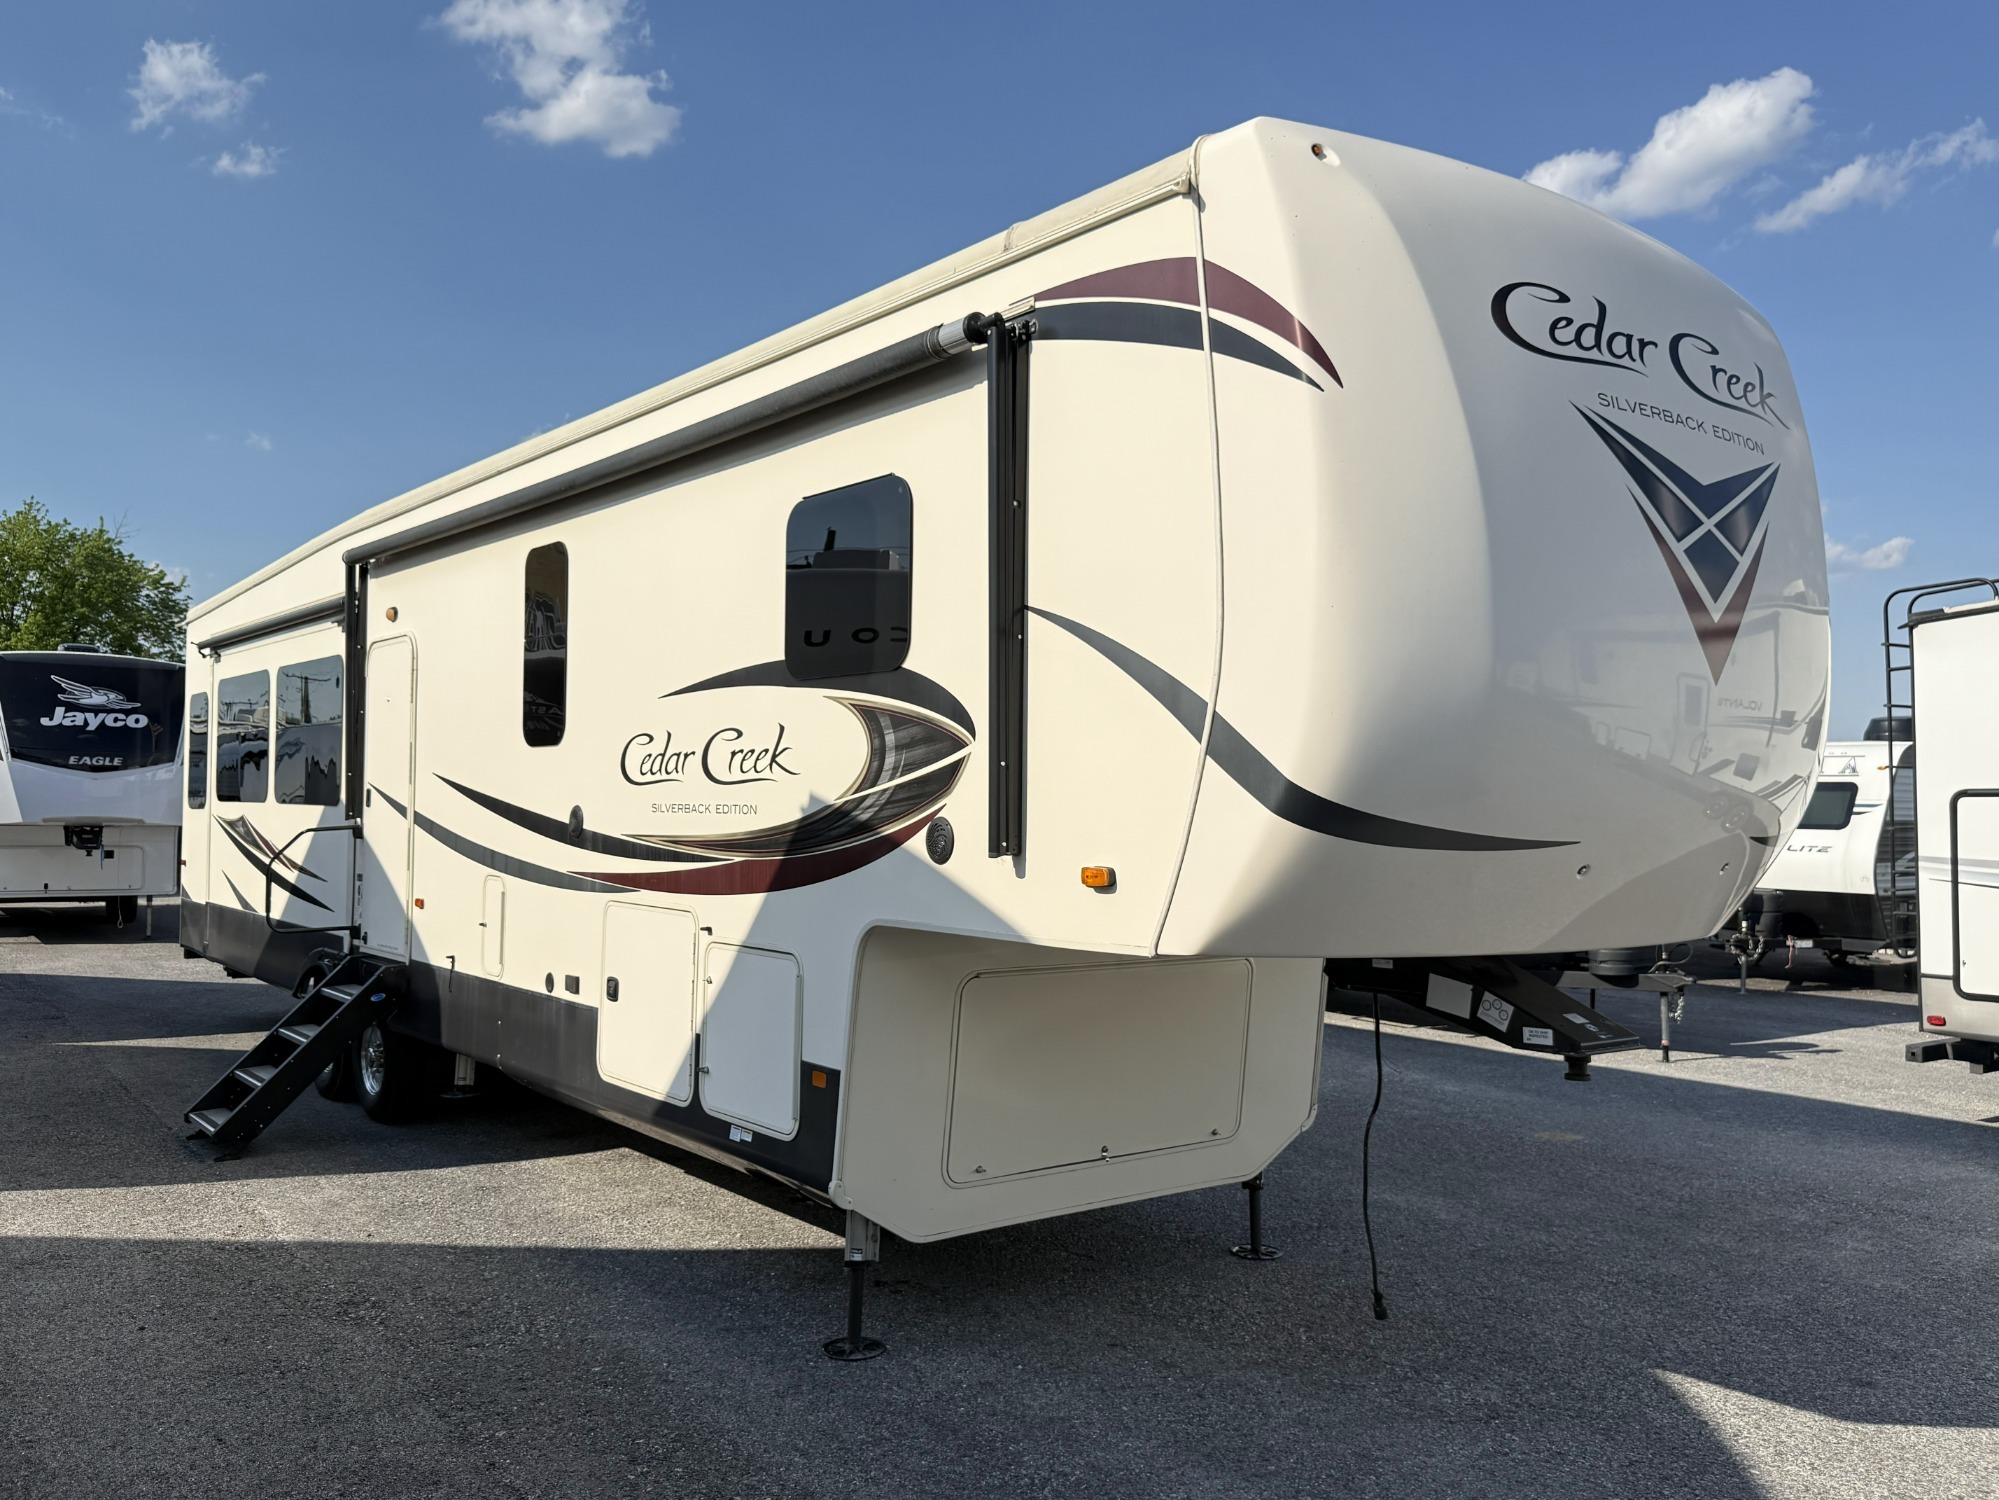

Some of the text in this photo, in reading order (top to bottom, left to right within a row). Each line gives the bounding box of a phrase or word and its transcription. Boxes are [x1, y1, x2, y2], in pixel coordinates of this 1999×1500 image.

[1491, 281, 1791, 430] Cedar Creek
[1597, 392, 1765, 455] SILVERBACK EDITION
[40, 706, 148, 731] Jayco
[68, 755, 124, 766] EAGLE
[620, 722, 802, 787] Cedar Creek
[651, 803, 758, 815] SILVERBACK EDITION
[1786, 845, 1832, 853] LITE
